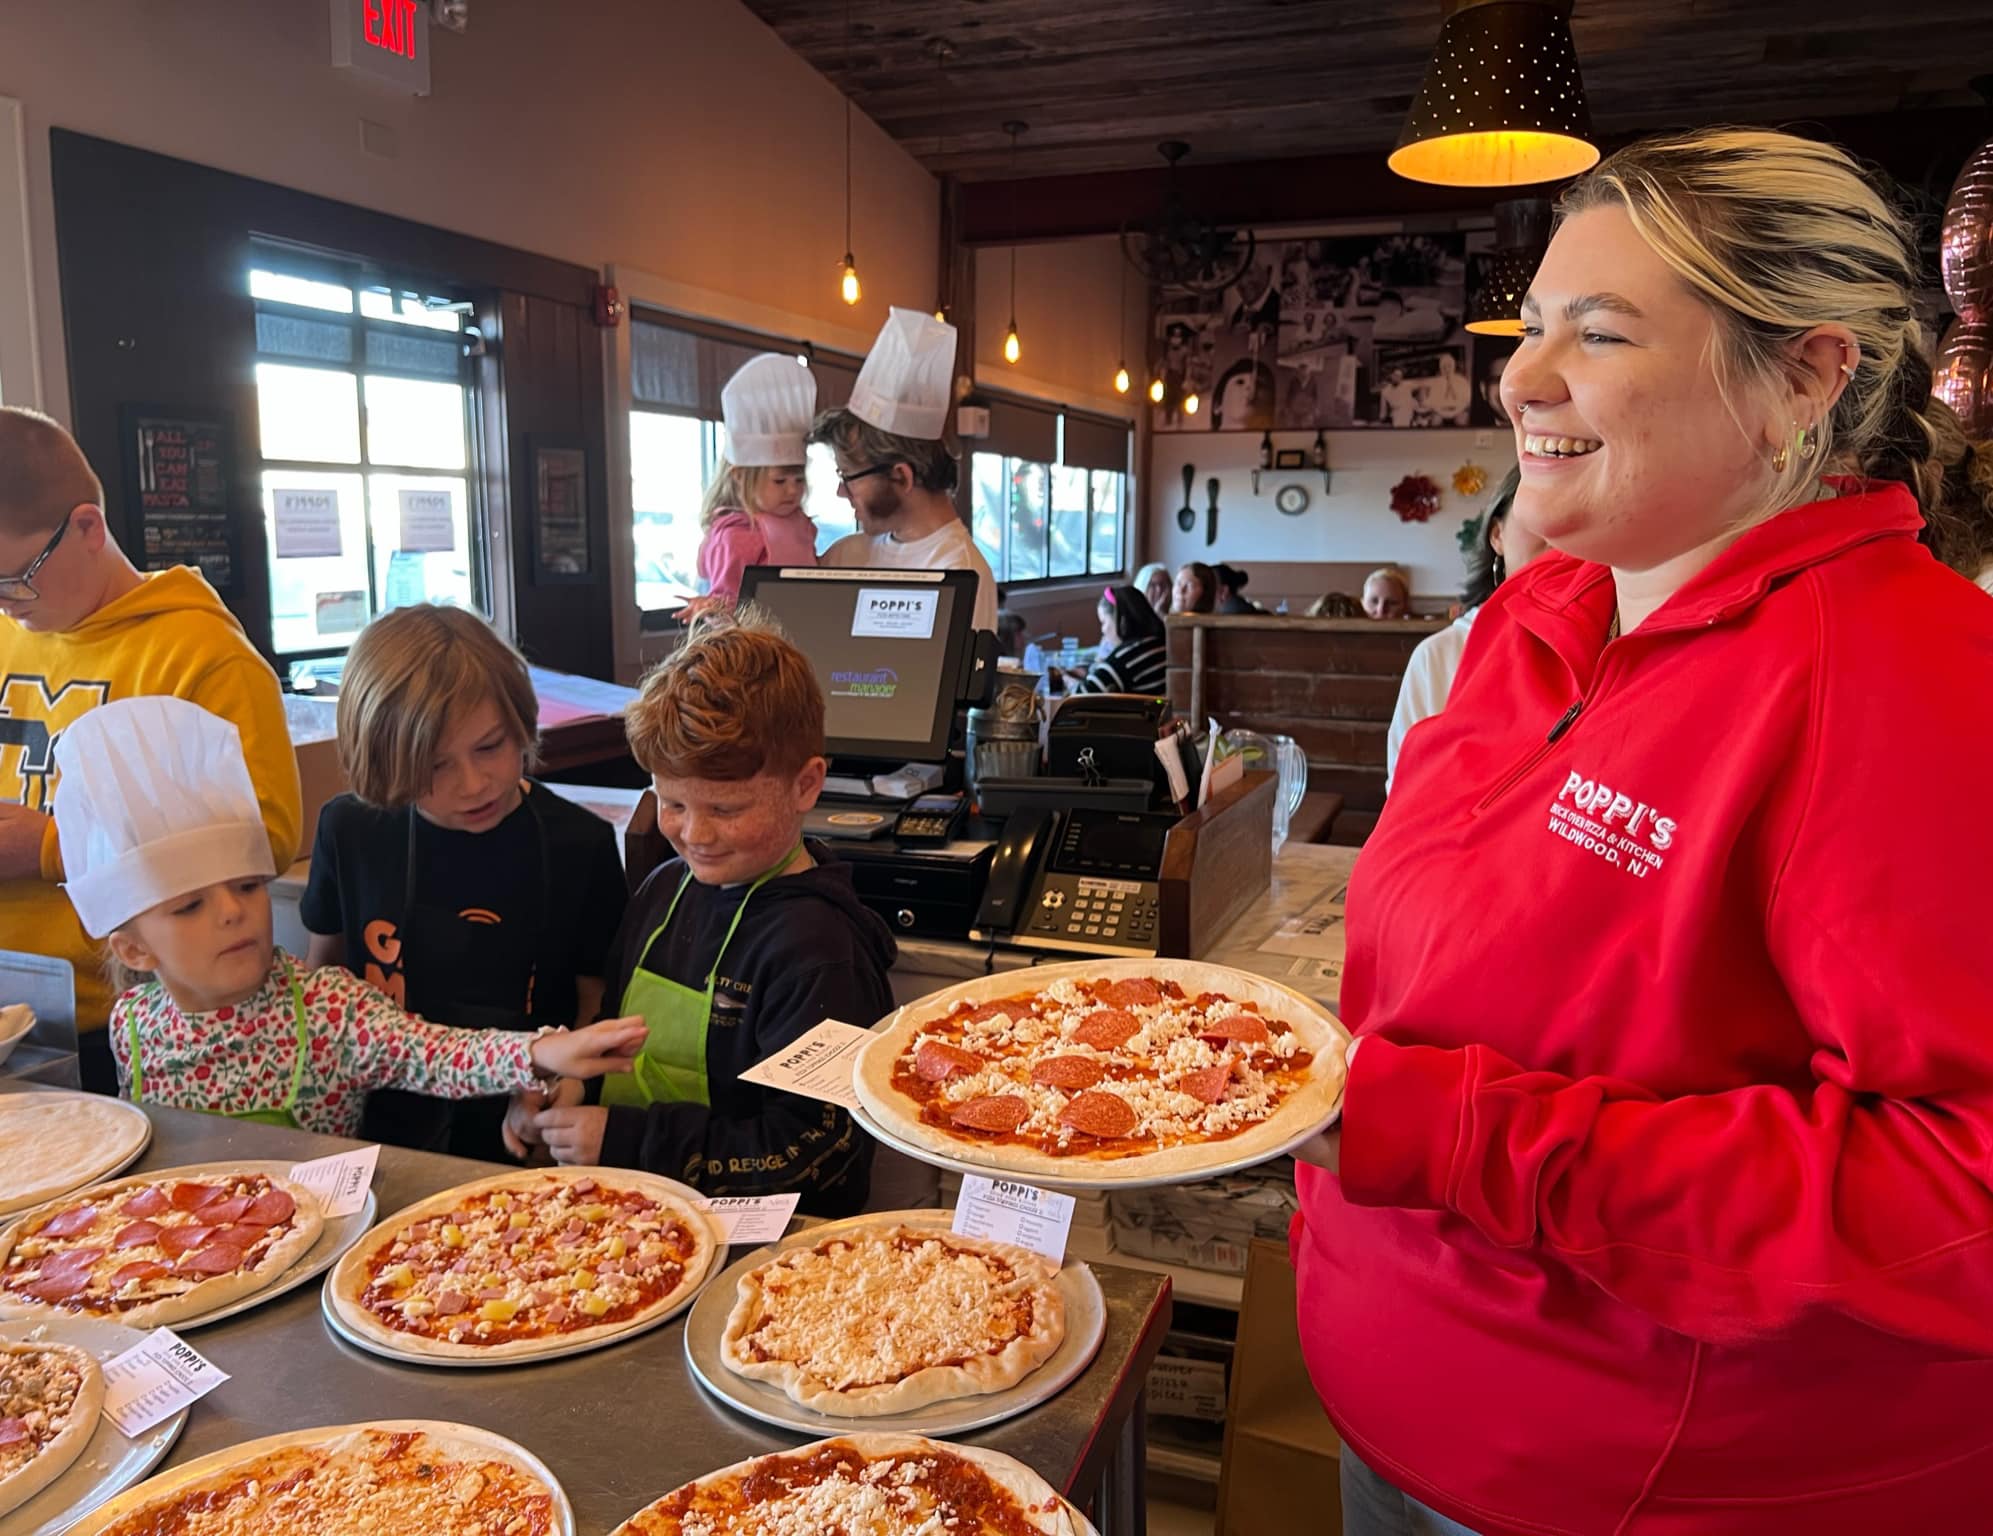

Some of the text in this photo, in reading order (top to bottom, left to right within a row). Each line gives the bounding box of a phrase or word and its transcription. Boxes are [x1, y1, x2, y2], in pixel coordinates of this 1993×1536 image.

[363, 0, 416, 60] EXIT
[156, 431, 186, 443] ALL
[870, 599, 922, 612] POPPI'S
[831, 671, 887, 684] restaurant
[849, 682, 896, 694] manager
[1558, 769, 1677, 850] POPPI'S
[1547, 816, 1649, 878] WILDWOOD, NJ
[1582, 820, 1607, 840] PIZZA
[1606, 832, 1619, 845] &
[1616, 836, 1664, 870] KITCHEN
[779, 1040, 826, 1070] POPPI'S
[710, 1197, 762, 1208] POPPI'S
[992, 1179, 1039, 1201] POPPI'S
[168, 1341, 207, 1373] POPPI'S
